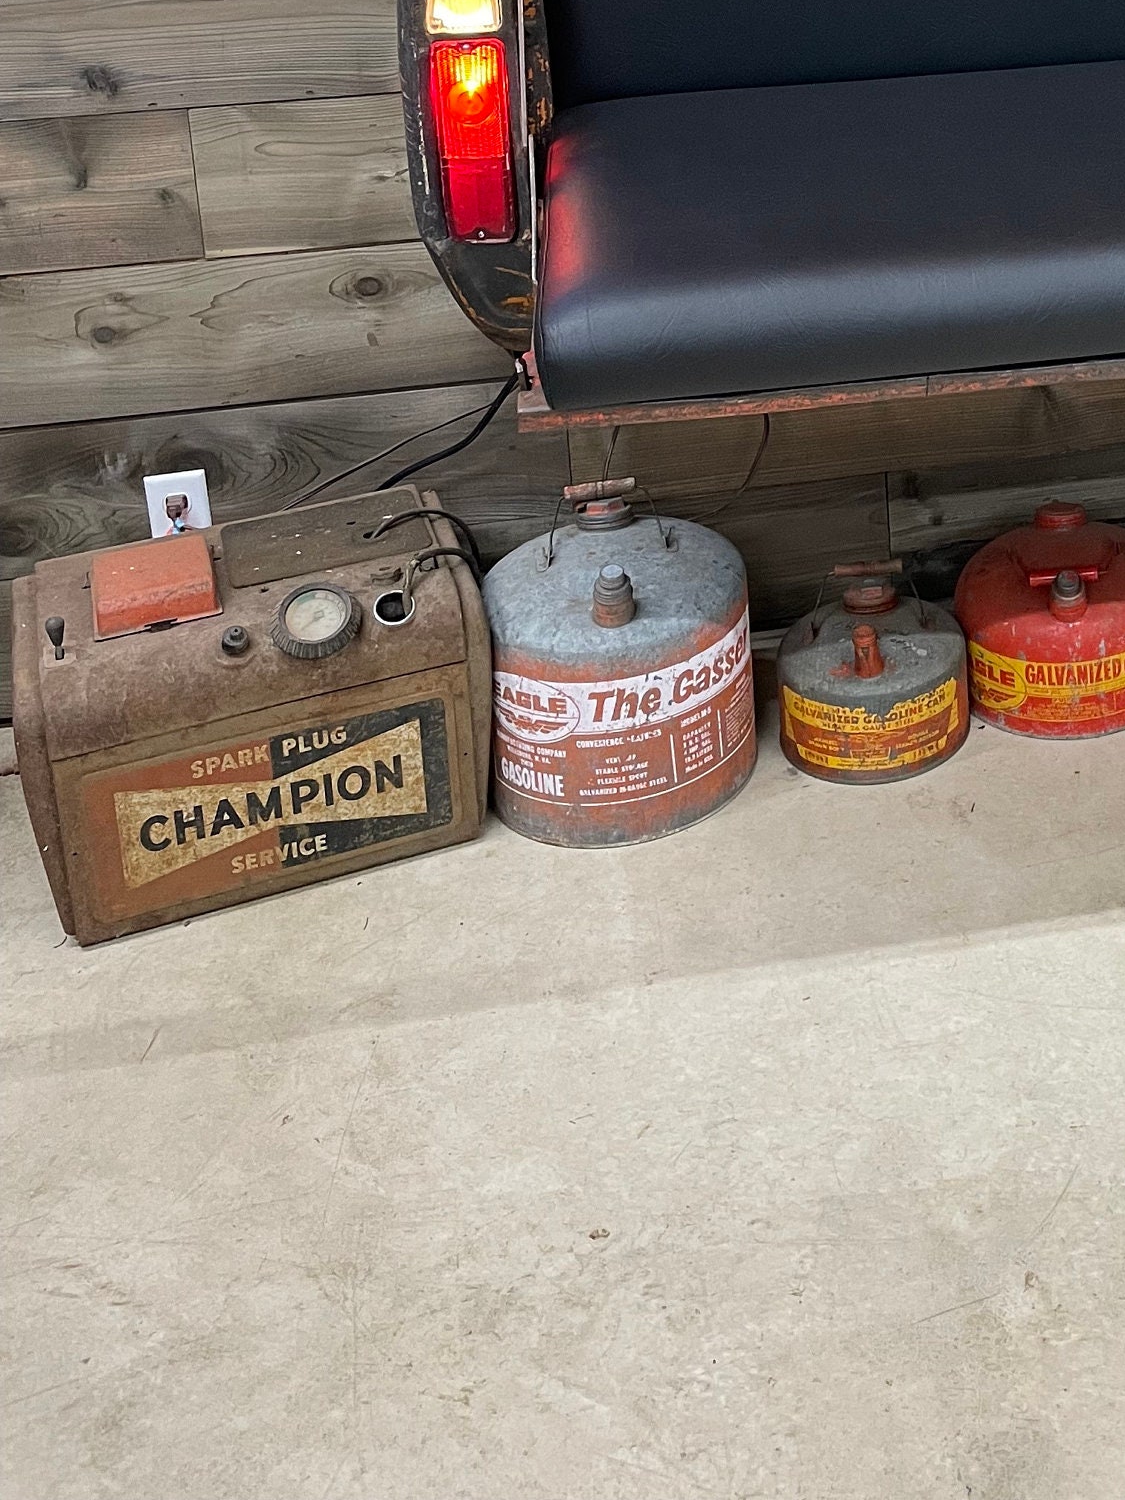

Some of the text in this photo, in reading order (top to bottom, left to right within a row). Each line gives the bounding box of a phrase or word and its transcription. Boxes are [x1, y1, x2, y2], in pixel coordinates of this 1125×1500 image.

[972, 657, 1015, 688] GLE
[1025, 657, 1121, 687] GALVANIZED
[588, 687, 662, 723] The
[793, 701, 859, 725] GALVANIZED
[926, 694, 946, 709] CAN
[576, 736, 625, 749] CONVENIENCE
[682, 721, 711, 741] CAPACITY
[190, 725, 348, 779] SPARK PLUG
[537, 747, 566, 759] COMPANY
[501, 757, 565, 797] GASOLINE
[579, 786, 618, 796] GALVANIZED
[648, 776, 668, 787] STEEL
[138, 754, 404, 852] CHAMPION
[231, 833, 328, 875] SERVICE
